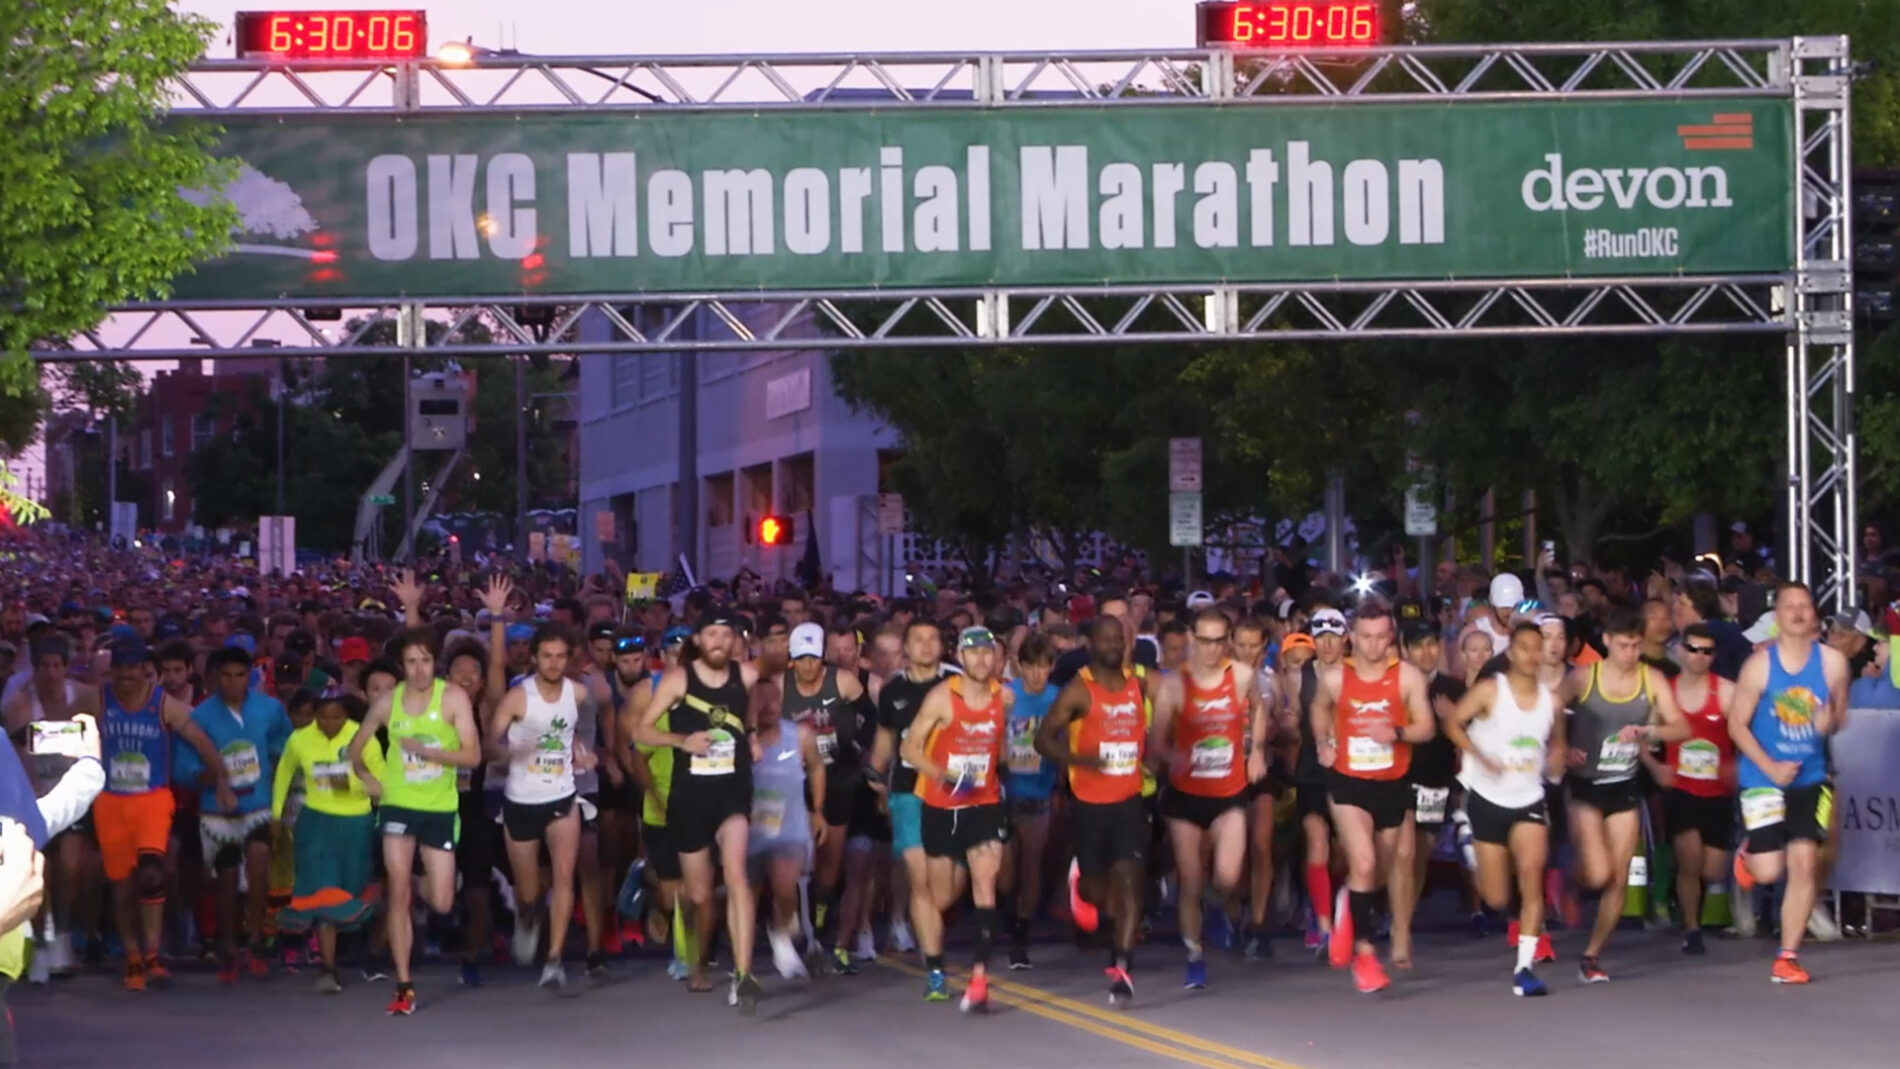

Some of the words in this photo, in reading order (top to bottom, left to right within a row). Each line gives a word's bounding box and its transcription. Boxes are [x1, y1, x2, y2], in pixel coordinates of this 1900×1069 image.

[366, 153, 537, 261] OKC
[567, 146, 990, 257] Memorial
[1020, 140, 1446, 250] Marathon
[1521, 153, 1733, 211] devon
[1584, 227, 1679, 259] #RunOKC
